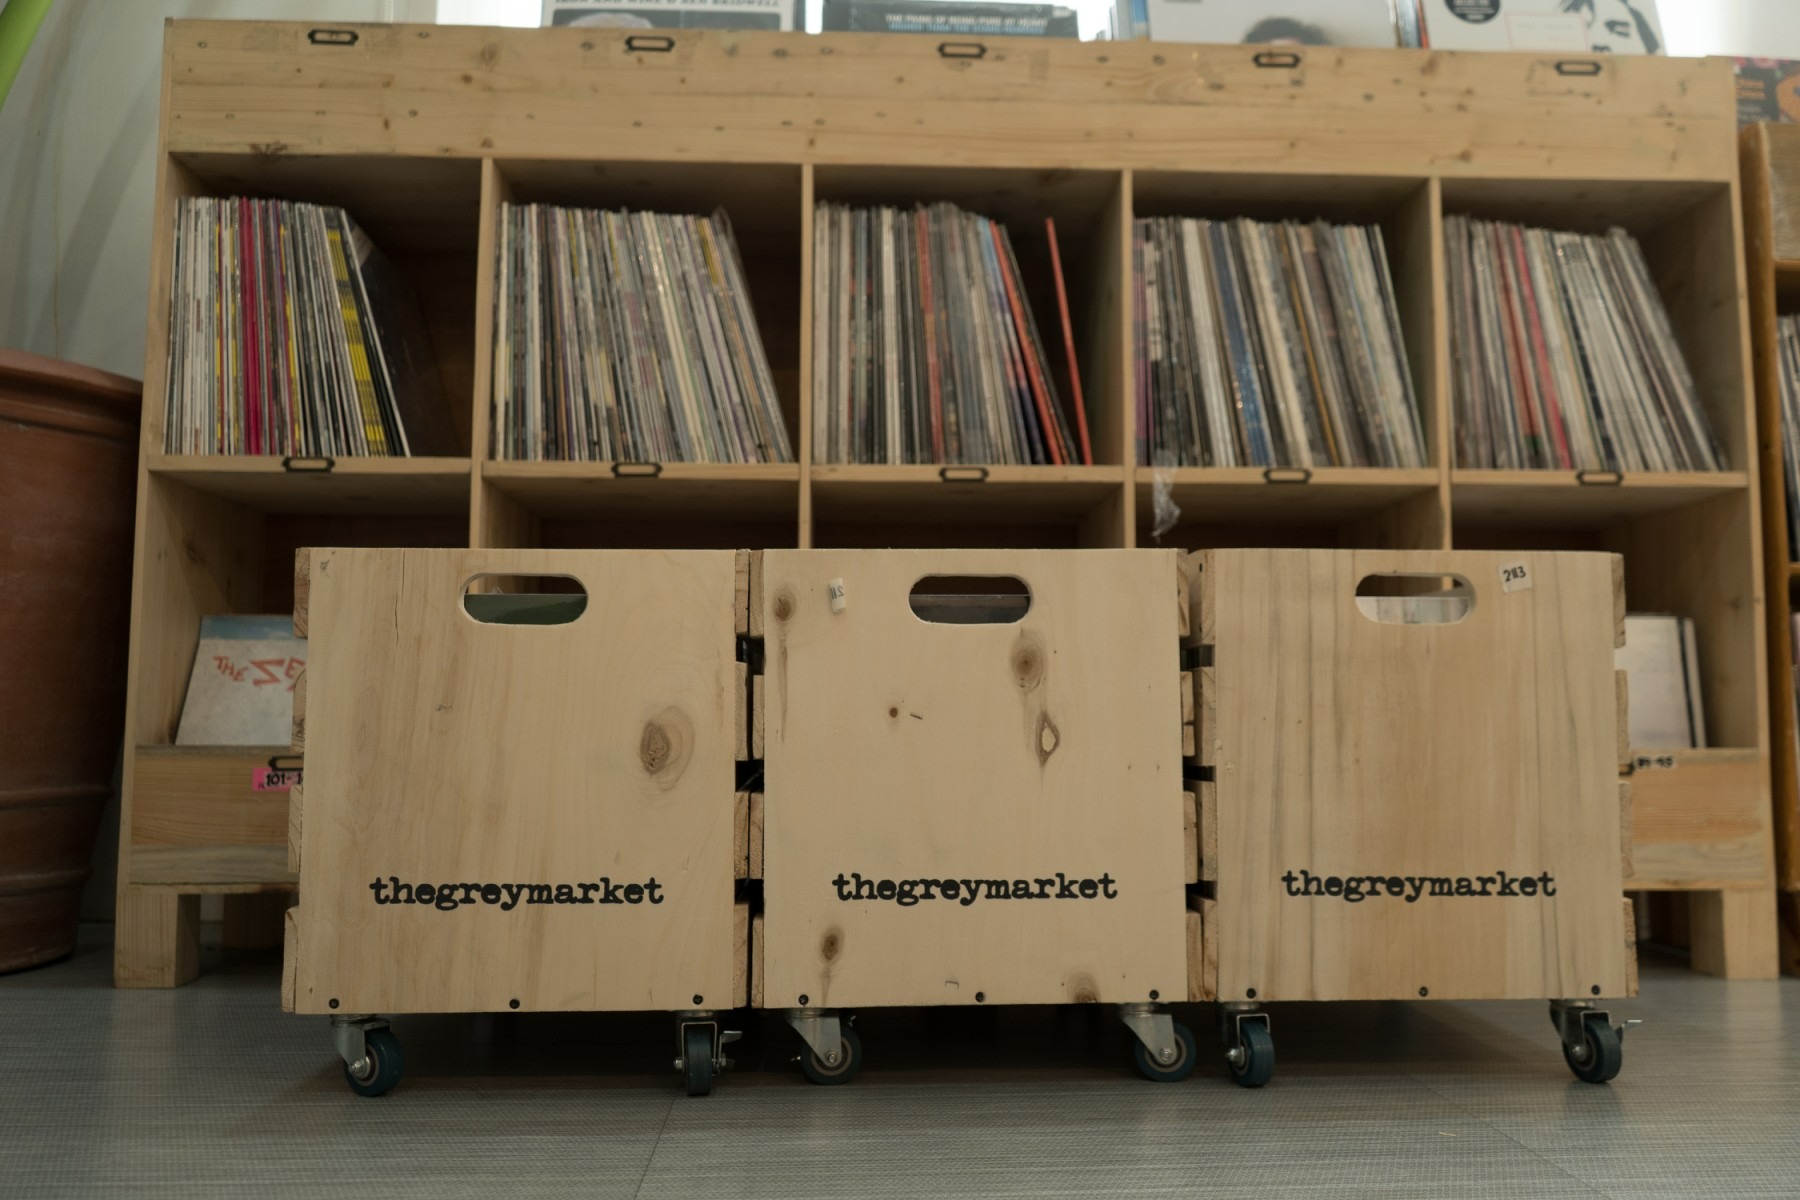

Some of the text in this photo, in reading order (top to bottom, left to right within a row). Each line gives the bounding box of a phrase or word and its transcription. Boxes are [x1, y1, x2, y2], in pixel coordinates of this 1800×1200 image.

[213, 655, 248, 682] THE
[369, 876, 664, 911] thegreymarket
[831, 872, 1118, 906] thegreymarket
[1281, 869, 1557, 902] thegreymarket
